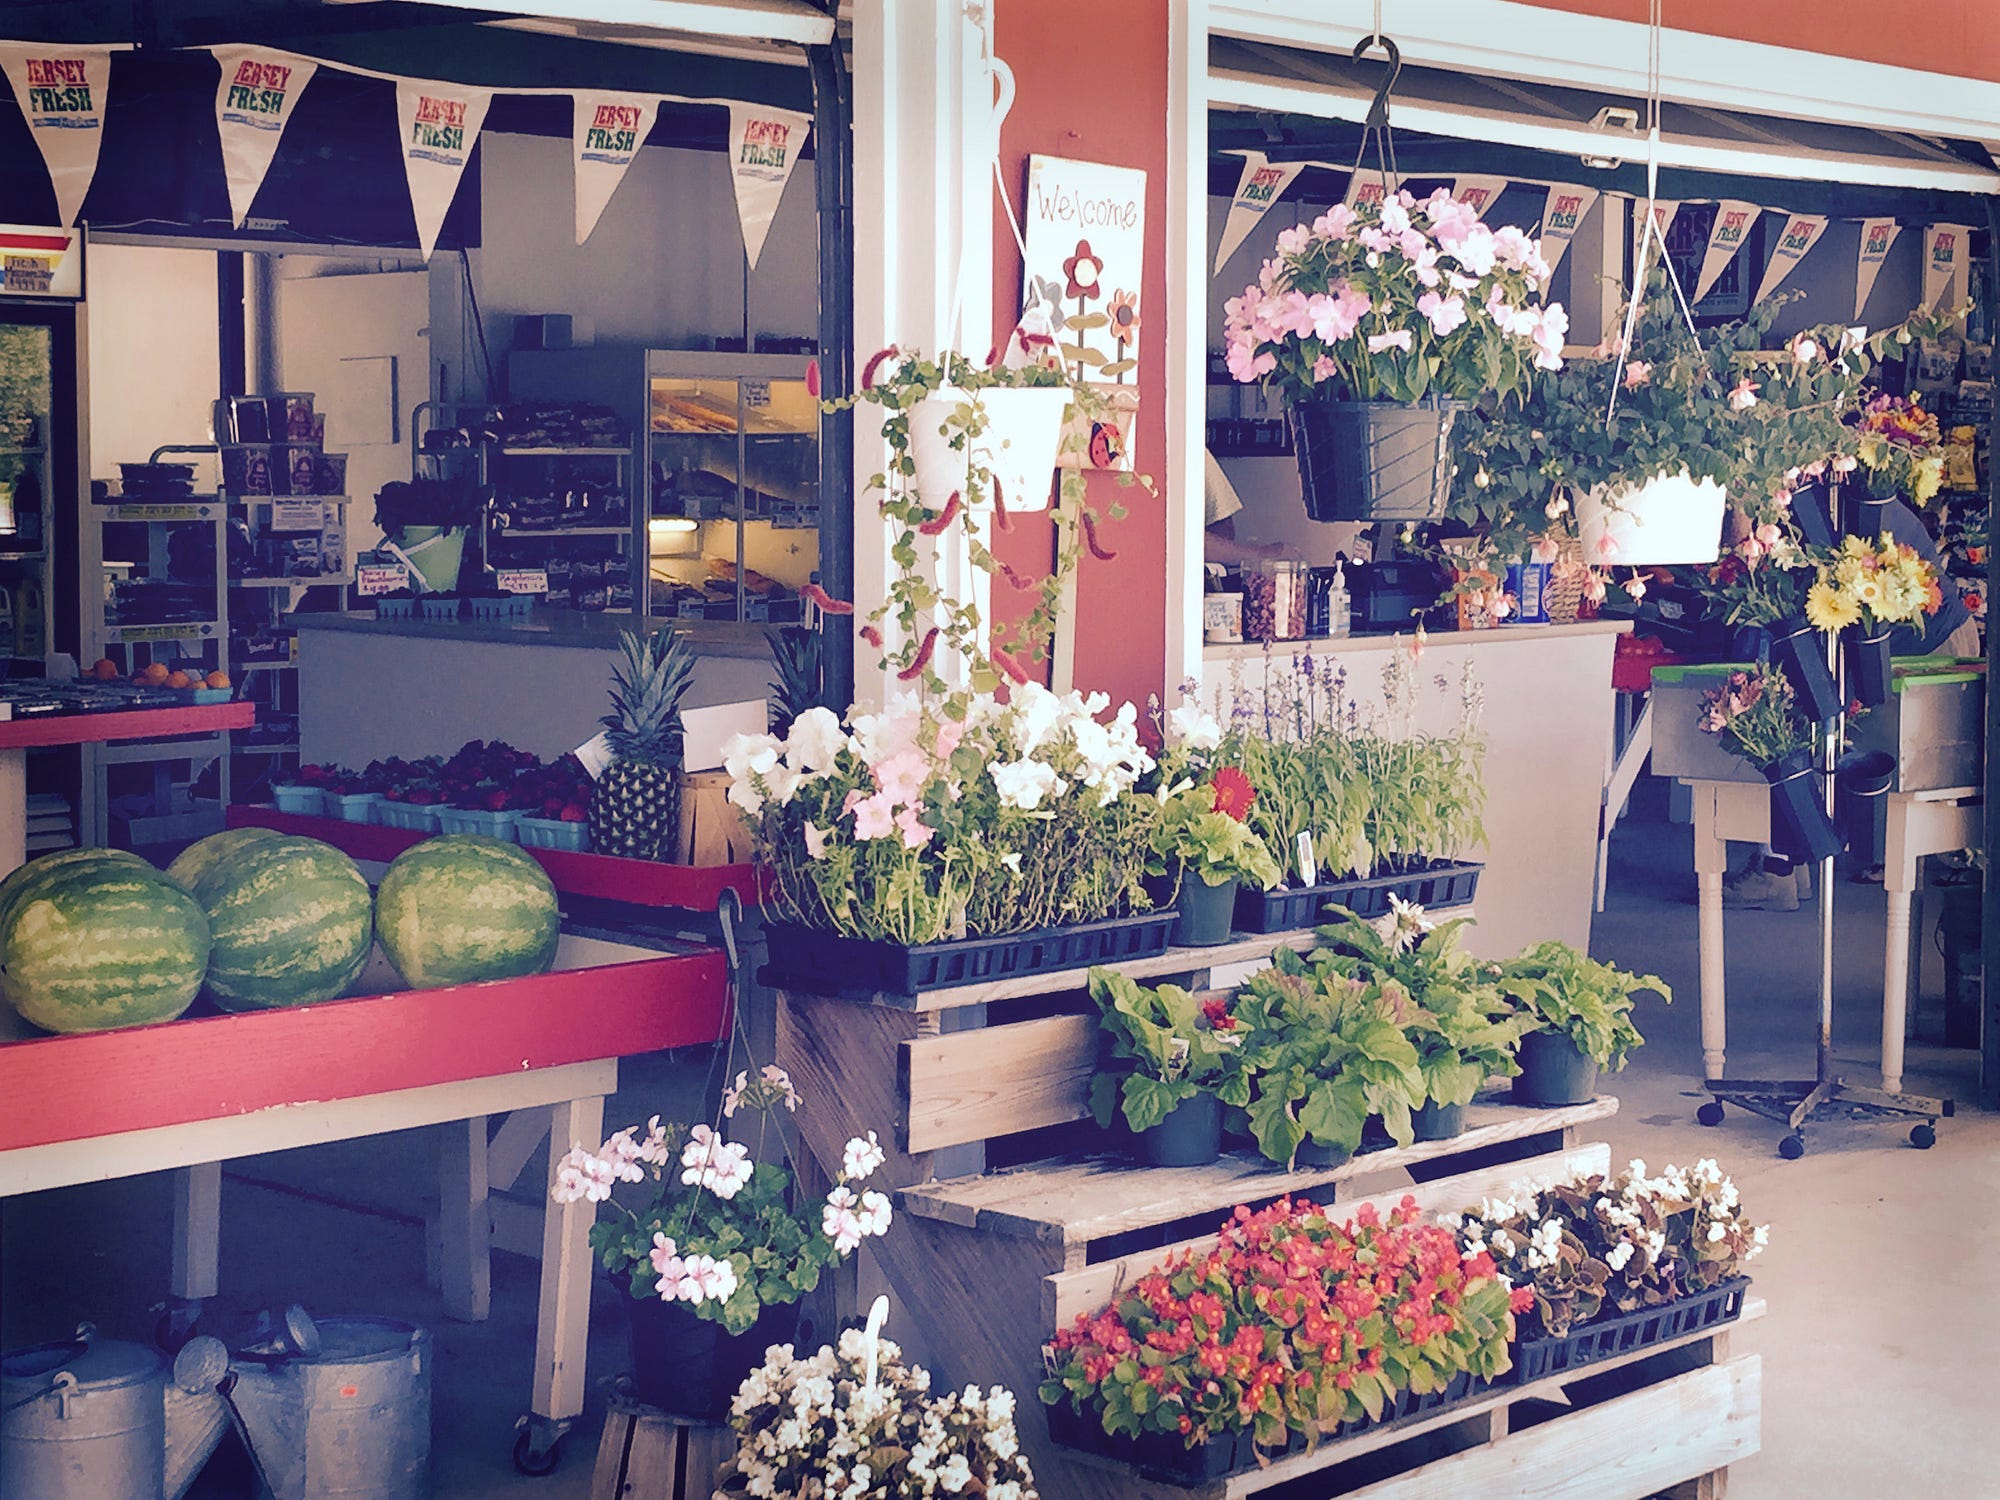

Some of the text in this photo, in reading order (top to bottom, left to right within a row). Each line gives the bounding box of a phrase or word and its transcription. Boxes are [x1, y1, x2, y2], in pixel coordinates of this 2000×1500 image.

[26, 59, 86, 82] JERSEY
[233, 60, 292, 88] JERSEY
[29, 87, 93, 112] FRESH
[226, 85, 285, 114] FRESH
[416, 96, 467, 123] JERSEY
[593, 105, 642, 127] JERSEY
[412, 122, 463, 151] FRESH
[586, 128, 636, 151] FRESH
[744, 120, 791, 144] JERSEY
[740, 144, 786, 168] FRESH
[1037, 183, 1138, 231] Welcome
